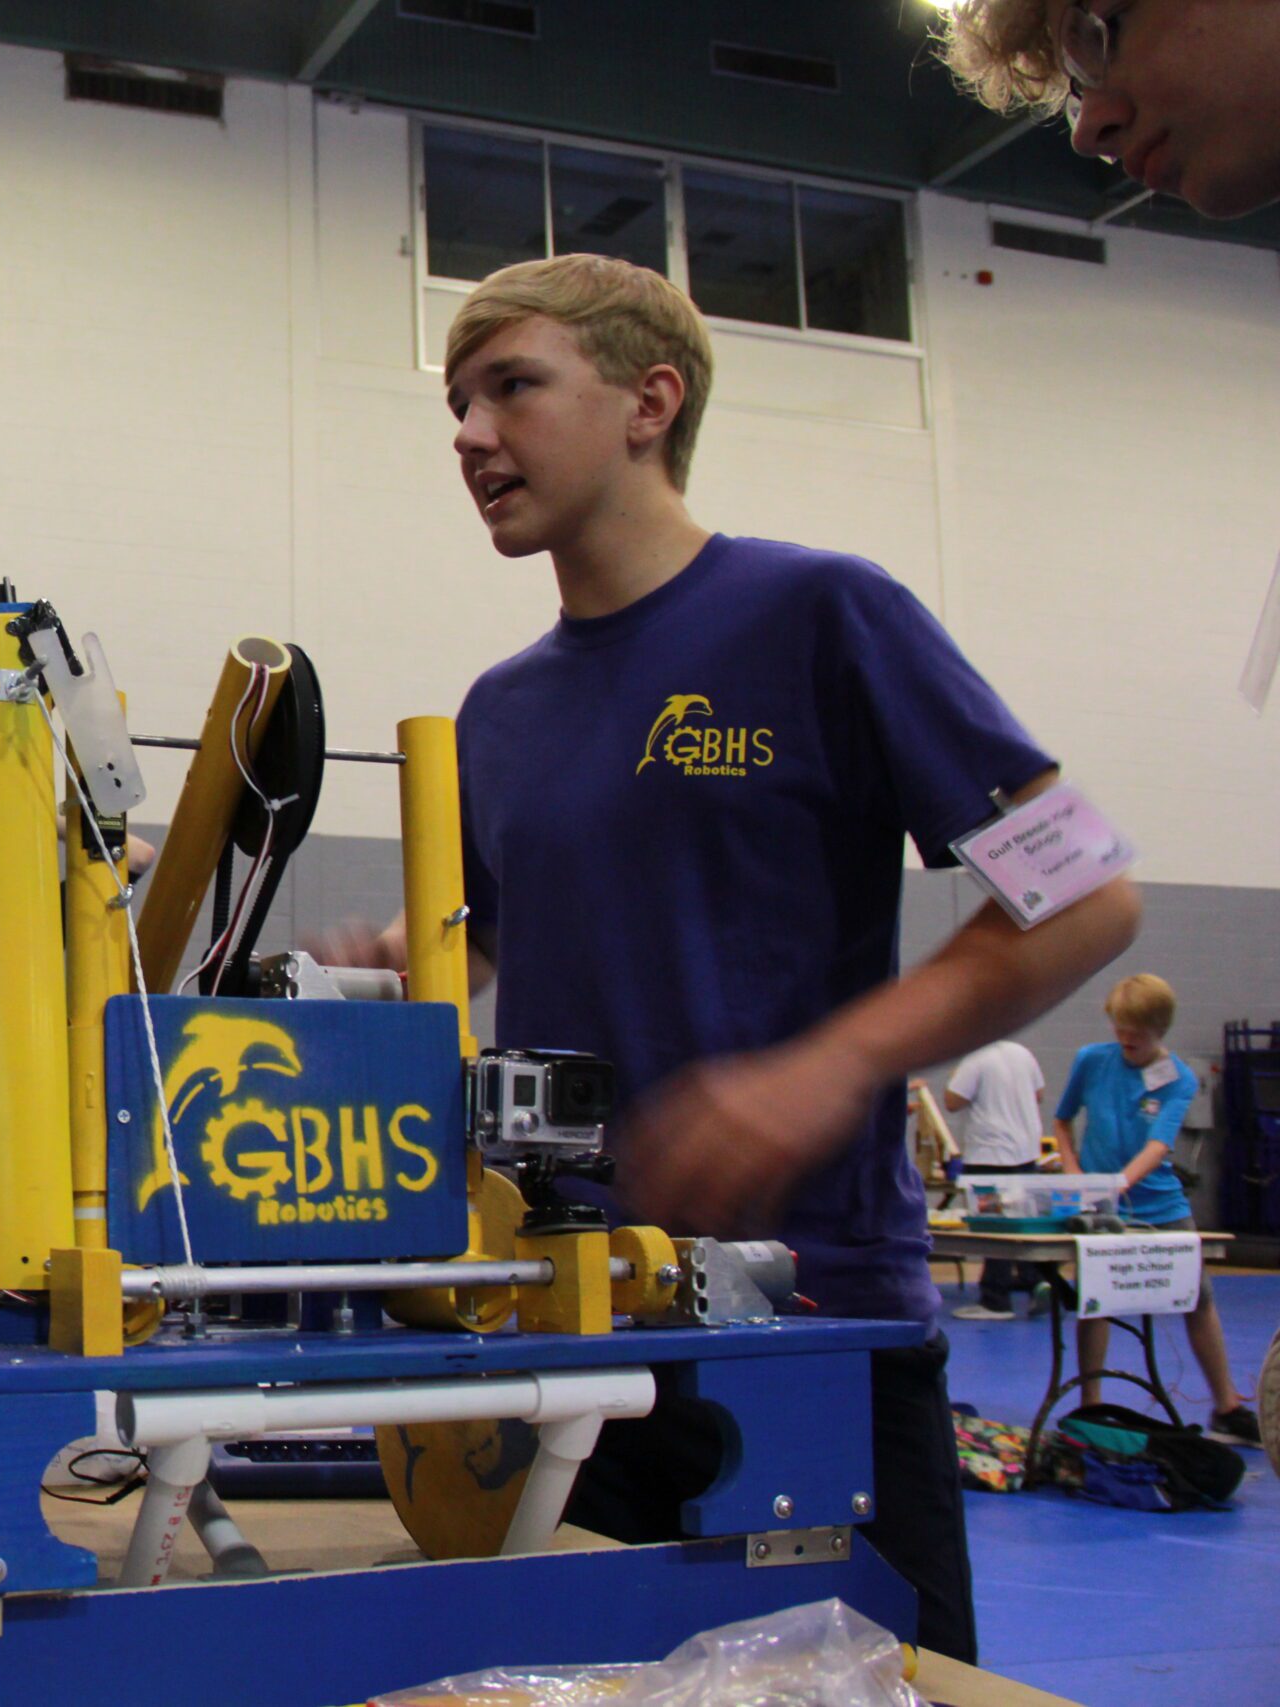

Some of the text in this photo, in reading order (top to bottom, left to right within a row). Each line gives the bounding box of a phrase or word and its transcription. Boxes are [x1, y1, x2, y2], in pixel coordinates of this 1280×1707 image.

[663, 725, 775, 766] GBHS
[684, 764, 747, 776] Robotics
[987, 840, 1014, 860] Gulf
[201, 1098, 439, 1200] GBHS
[257, 1196, 388, 1225] Robotics
[1086, 1245, 1194, 1257] Seacoast Collegiate
[1109, 1262, 1174, 1275] High School
[1112, 1280, 1141, 1290] Team
